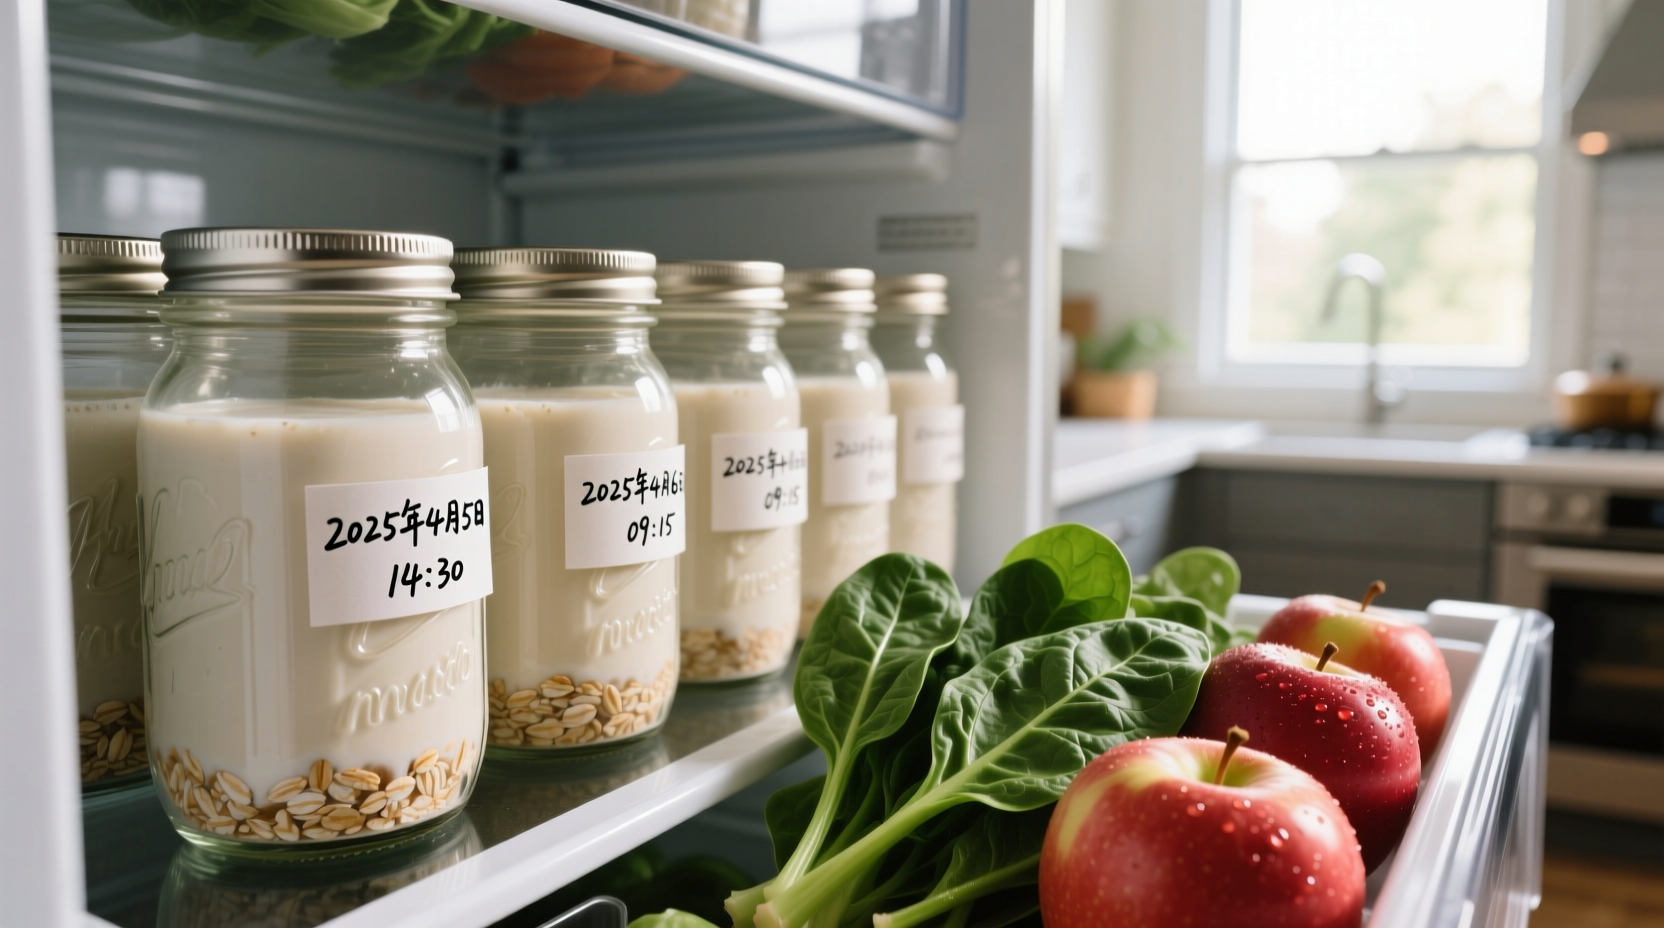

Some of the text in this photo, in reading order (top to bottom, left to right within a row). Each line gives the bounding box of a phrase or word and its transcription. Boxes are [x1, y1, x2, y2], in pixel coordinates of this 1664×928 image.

[324, 498, 485, 551] 2025年4月5日
[627, 512, 676, 547] 09:15
[388, 557, 464, 598] 14:30
